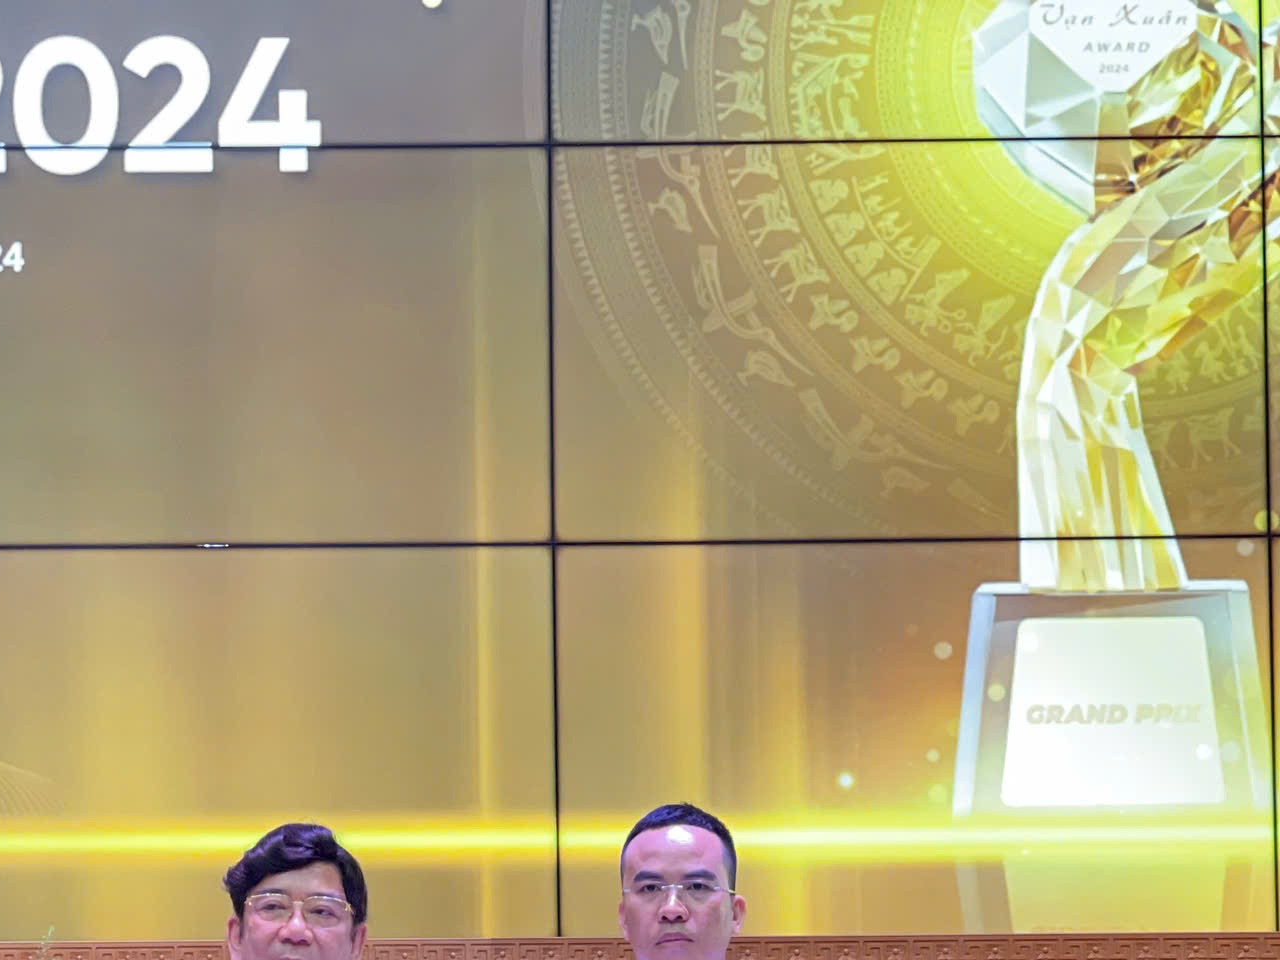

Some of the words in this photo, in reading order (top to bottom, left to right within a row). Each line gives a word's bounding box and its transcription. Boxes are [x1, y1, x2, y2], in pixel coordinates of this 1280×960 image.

[1082, 41, 1151, 54] AWARD
[1098, 63, 1130, 75] 2024
[1025, 704, 1129, 725] GRAND
